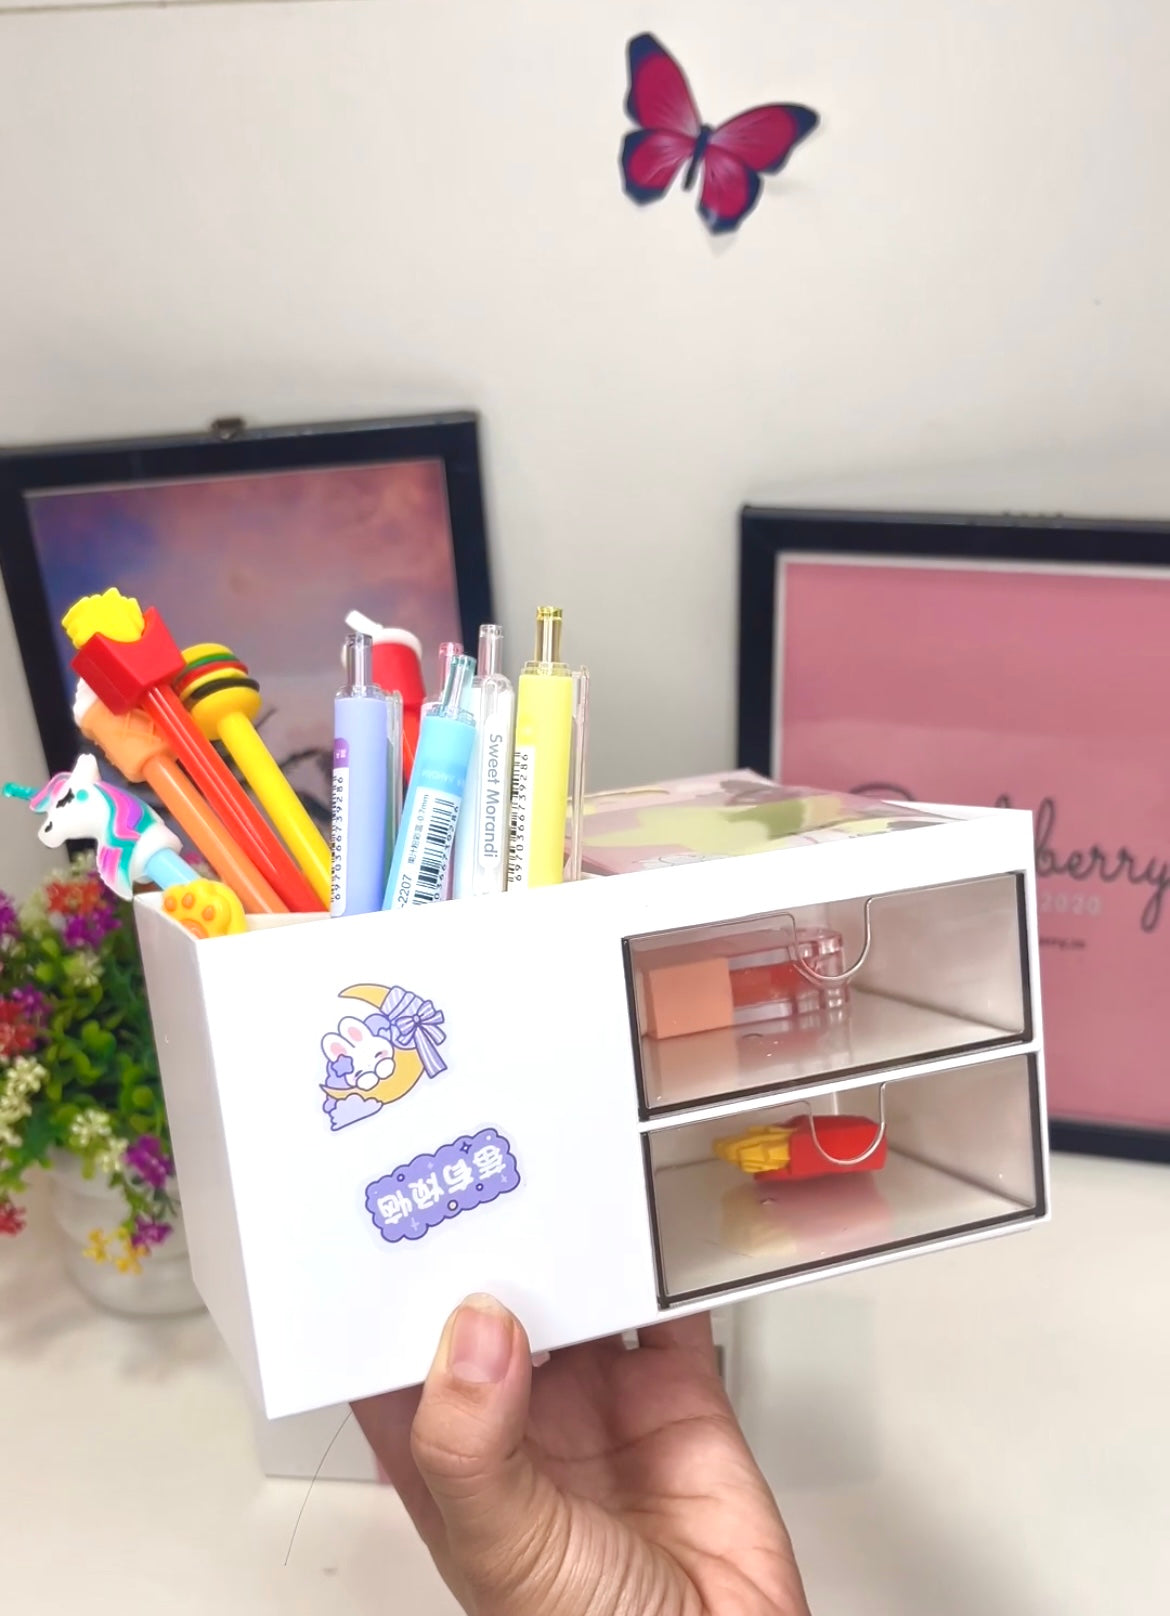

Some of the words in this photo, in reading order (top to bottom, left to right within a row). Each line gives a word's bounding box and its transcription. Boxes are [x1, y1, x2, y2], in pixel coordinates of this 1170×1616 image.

[487, 733, 503, 784] Sweet
[334, 776, 344, 900] 6970366739286
[483, 789, 500, 858] Morandi
[515, 754, 529, 882] 6970366739286
